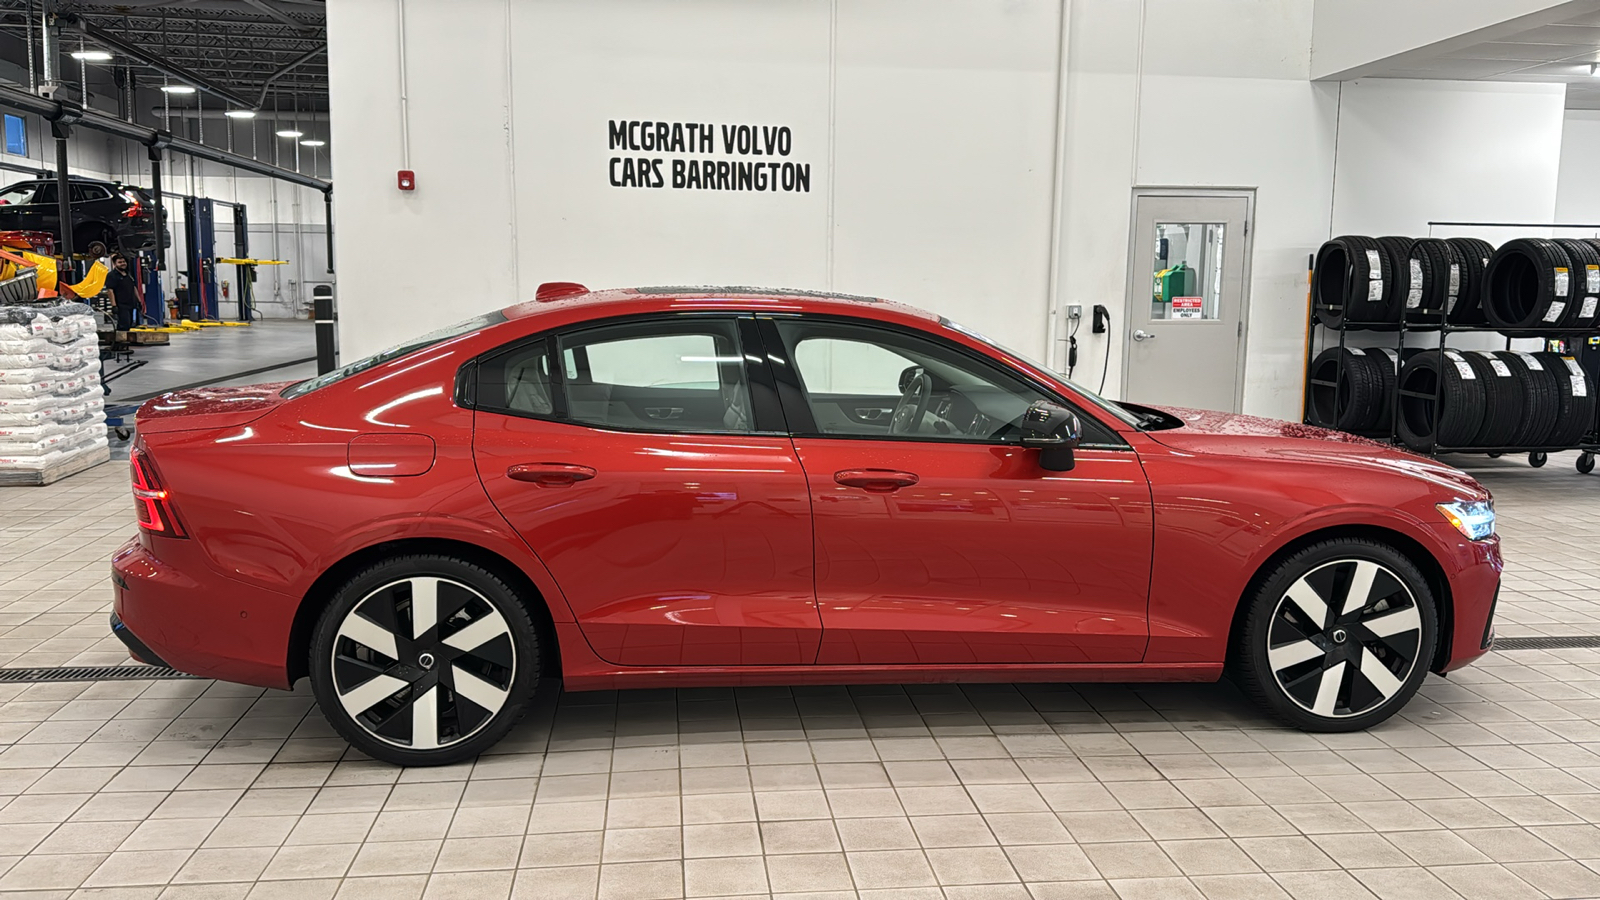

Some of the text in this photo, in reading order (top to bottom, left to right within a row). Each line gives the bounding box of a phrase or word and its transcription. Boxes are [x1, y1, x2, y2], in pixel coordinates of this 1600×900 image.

[608, 119, 792, 156] MCGRATH VOLVO
[609, 157, 810, 193] CARS BARRINGTON
